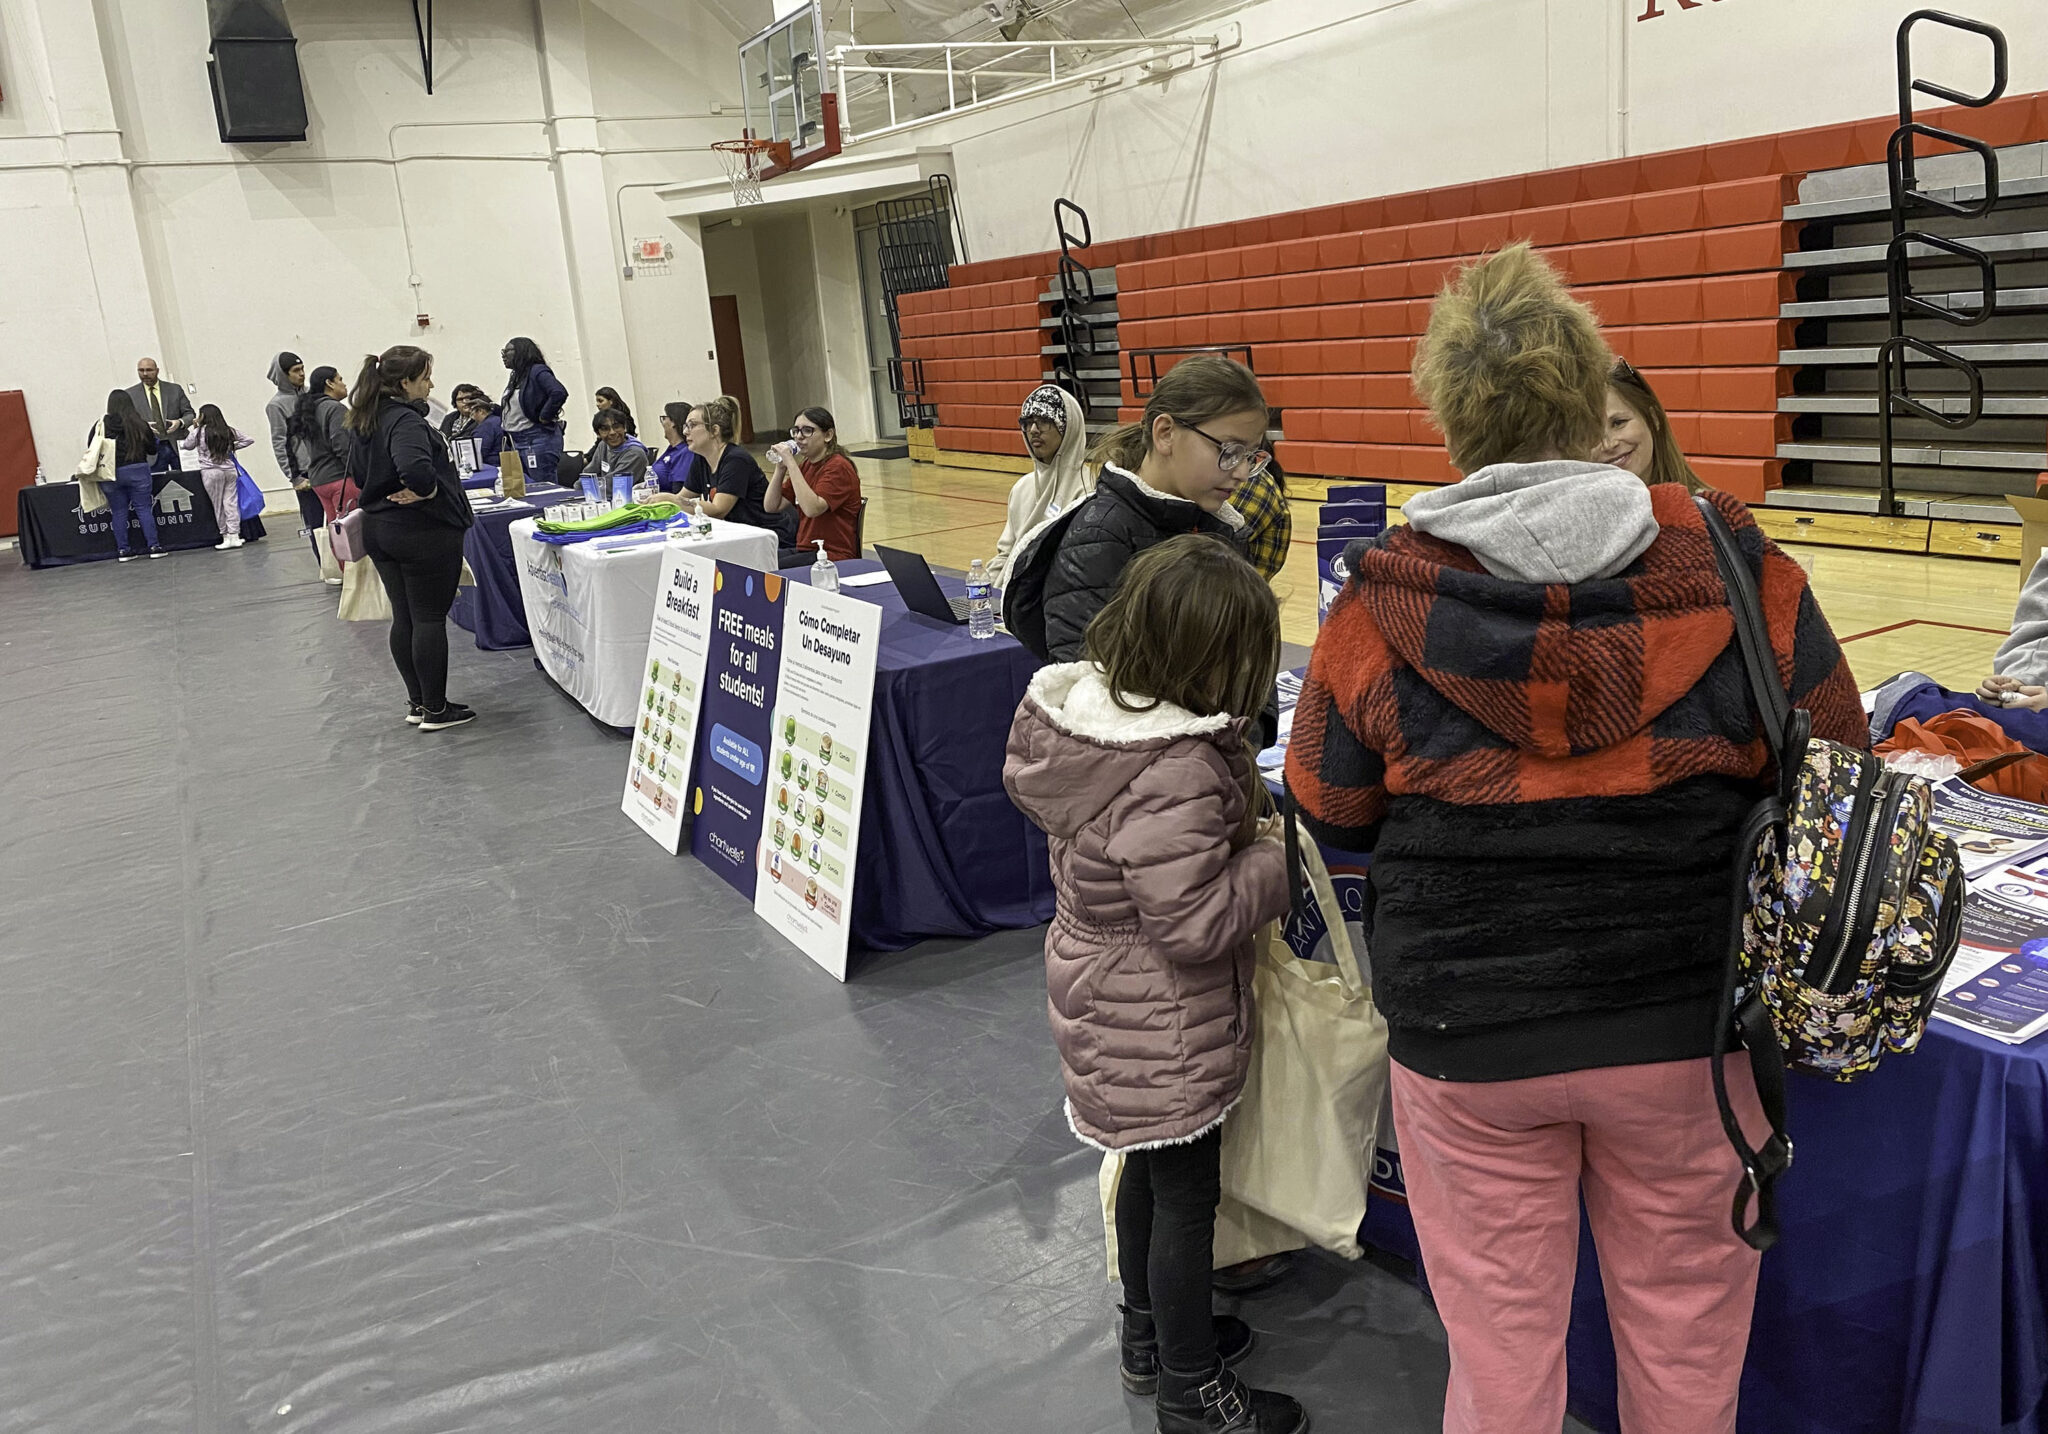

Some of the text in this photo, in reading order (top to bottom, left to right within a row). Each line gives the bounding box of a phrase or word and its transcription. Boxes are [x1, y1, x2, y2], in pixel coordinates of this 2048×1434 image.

[79, 514, 193, 534] SUPR UNIT
[673, 568, 698, 593] Build a
[666, 590, 700, 620] Breakfast
[718, 608, 744, 637] FREE
[744, 625, 775, 650] meals
[799, 610, 861, 645] Cómo Completar
[730, 642, 744, 667] for
[745, 651, 758, 674] all
[802, 634, 851, 665] Un Desayuno
[719, 671, 765, 709] students!
[839, 752, 850, 762] Comida
[1959, 787, 2038, 811] EKG TECHNICIAN
[709, 832, 741, 862] chartwells
[1977, 898, 2003, 912] You
[2004, 910, 2030, 920] can
